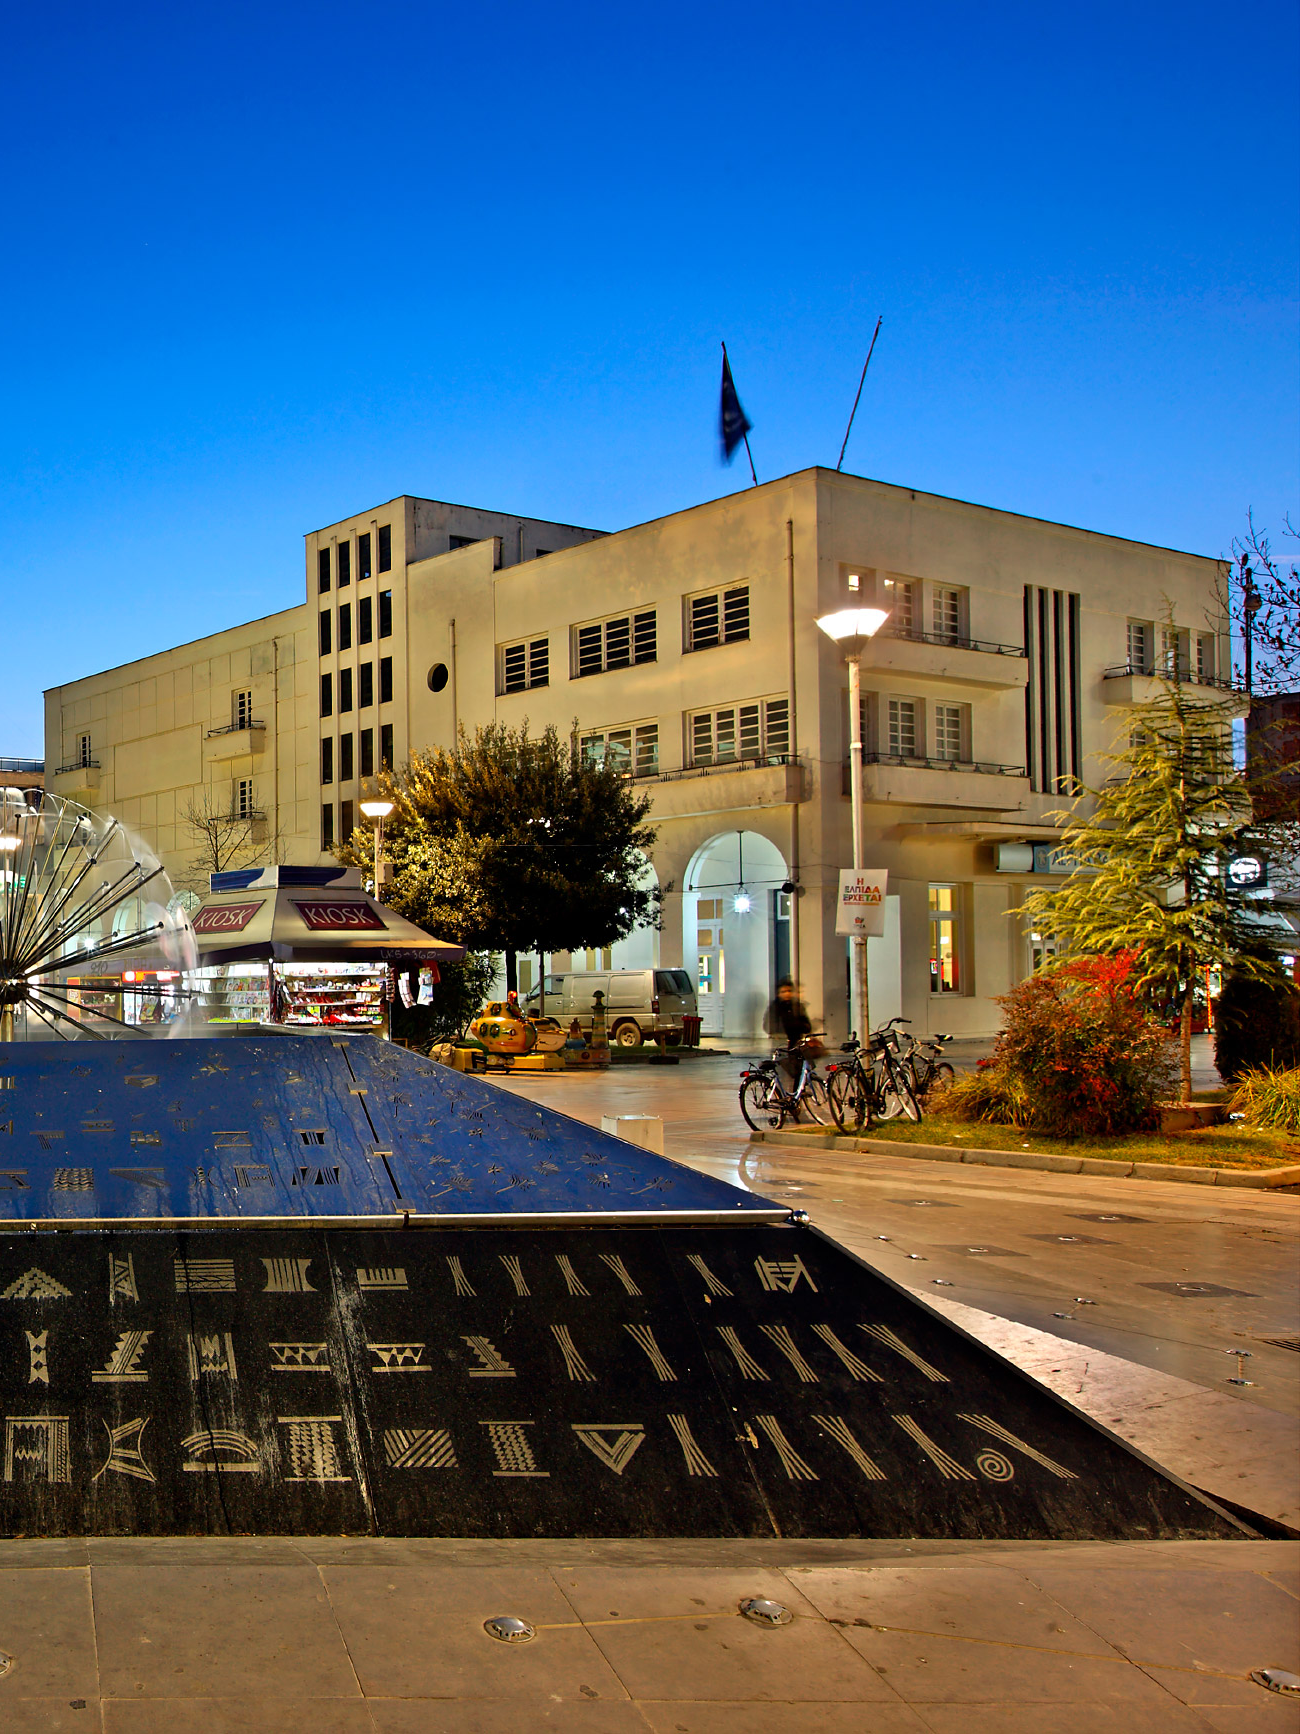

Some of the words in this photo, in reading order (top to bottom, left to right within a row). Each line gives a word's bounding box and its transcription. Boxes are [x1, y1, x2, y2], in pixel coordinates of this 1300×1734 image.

[856, 877, 864, 886] Η
[844, 886, 881, 894] ΕΛΠΙΔΑ
[843, 893, 882, 902] ΕΡΧΕΤΑΙ
[194, 908, 252, 928] KIOSK
[304, 907, 375, 925] KIOSK
